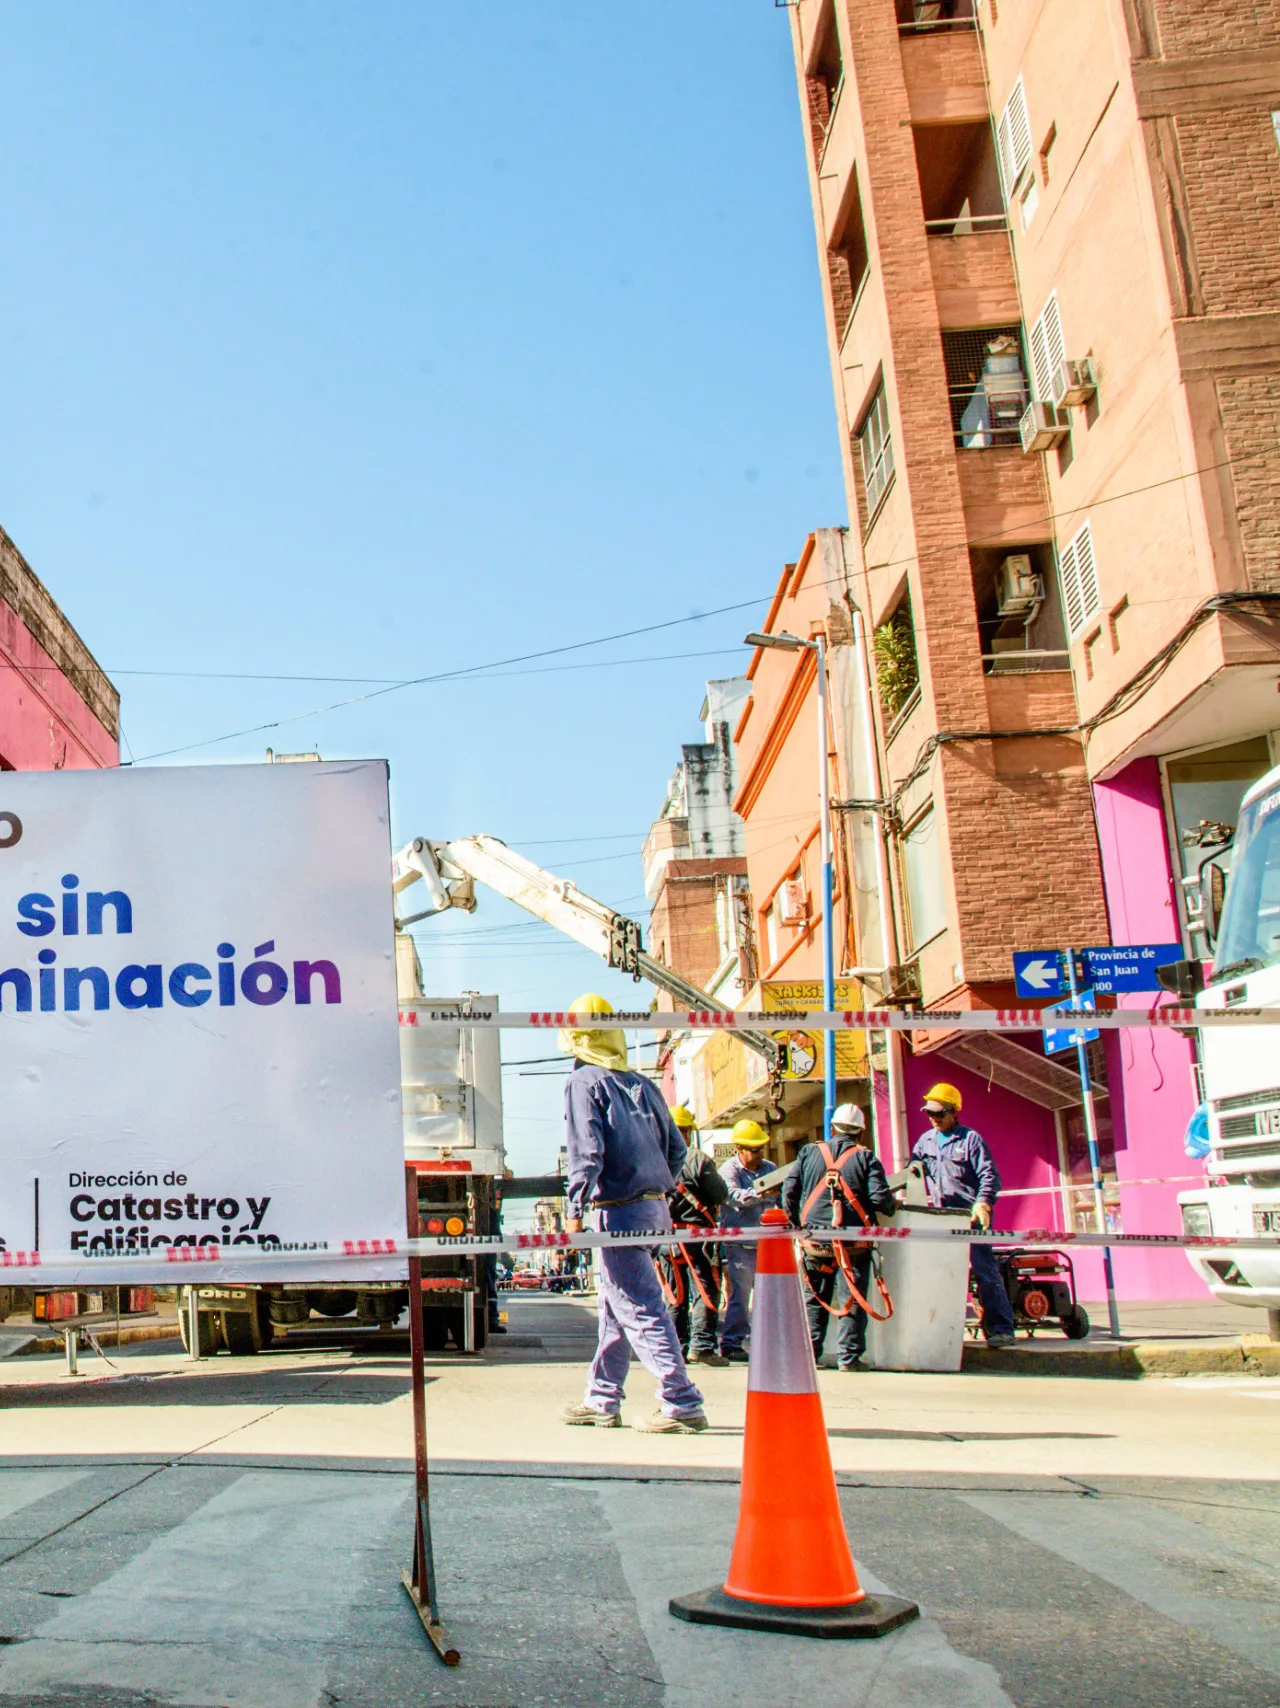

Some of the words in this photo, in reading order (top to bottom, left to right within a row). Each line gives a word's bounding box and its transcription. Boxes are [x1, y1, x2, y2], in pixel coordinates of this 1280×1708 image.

[15, 872, 134, 938] sin
[1087, 948, 1140, 962] Provincia
[1141, 947, 1156, 960] de
[1089, 965, 1112, 977] San
[1113, 964, 1140, 977] Juan
[69, 1170, 159, 1188] Dirección
[162, 1170, 188, 1187] de
[69, 1193, 240, 1222] Catastro
[245, 1196, 272, 1230] y
